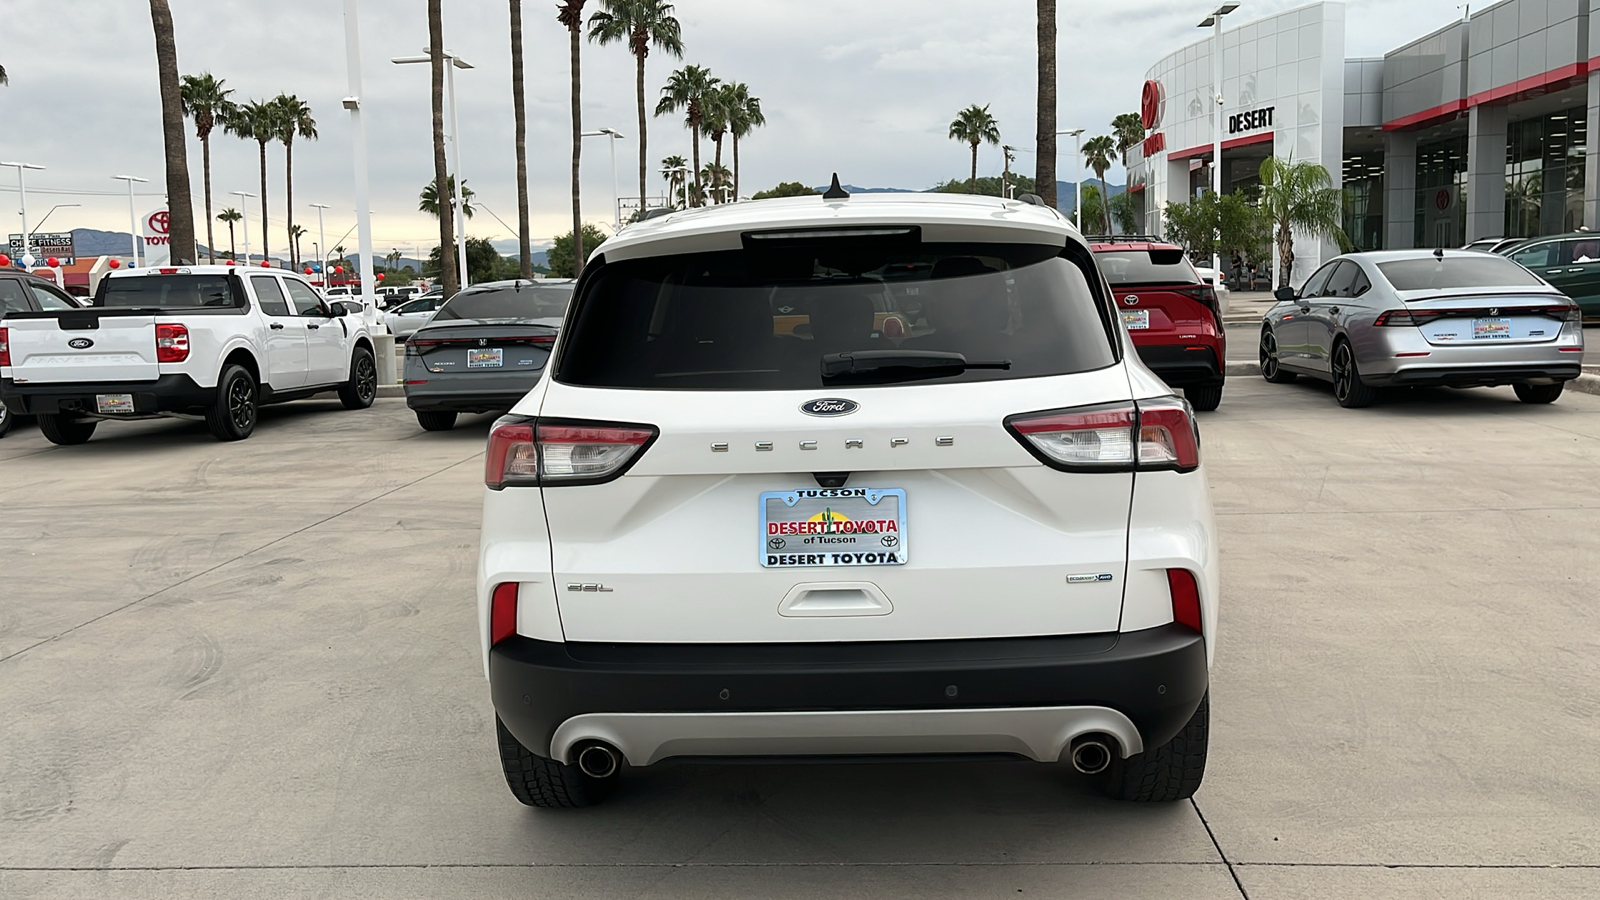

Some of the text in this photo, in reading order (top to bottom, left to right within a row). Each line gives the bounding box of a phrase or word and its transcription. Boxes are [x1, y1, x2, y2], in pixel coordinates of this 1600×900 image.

[1229, 106, 1275, 134] DESERT
[38, 238, 71, 246] FITNESS
[812, 400, 846, 412] Ford
[711, 435, 954, 452] ESCAPE
[797, 489, 867, 497] TUCSON
[768, 520, 897, 535] DESERT TOYOTA
[817, 536, 856, 544] Tucson
[767, 552, 898, 566] DESERT TOYOTA
[567, 583, 613, 592] SEL
